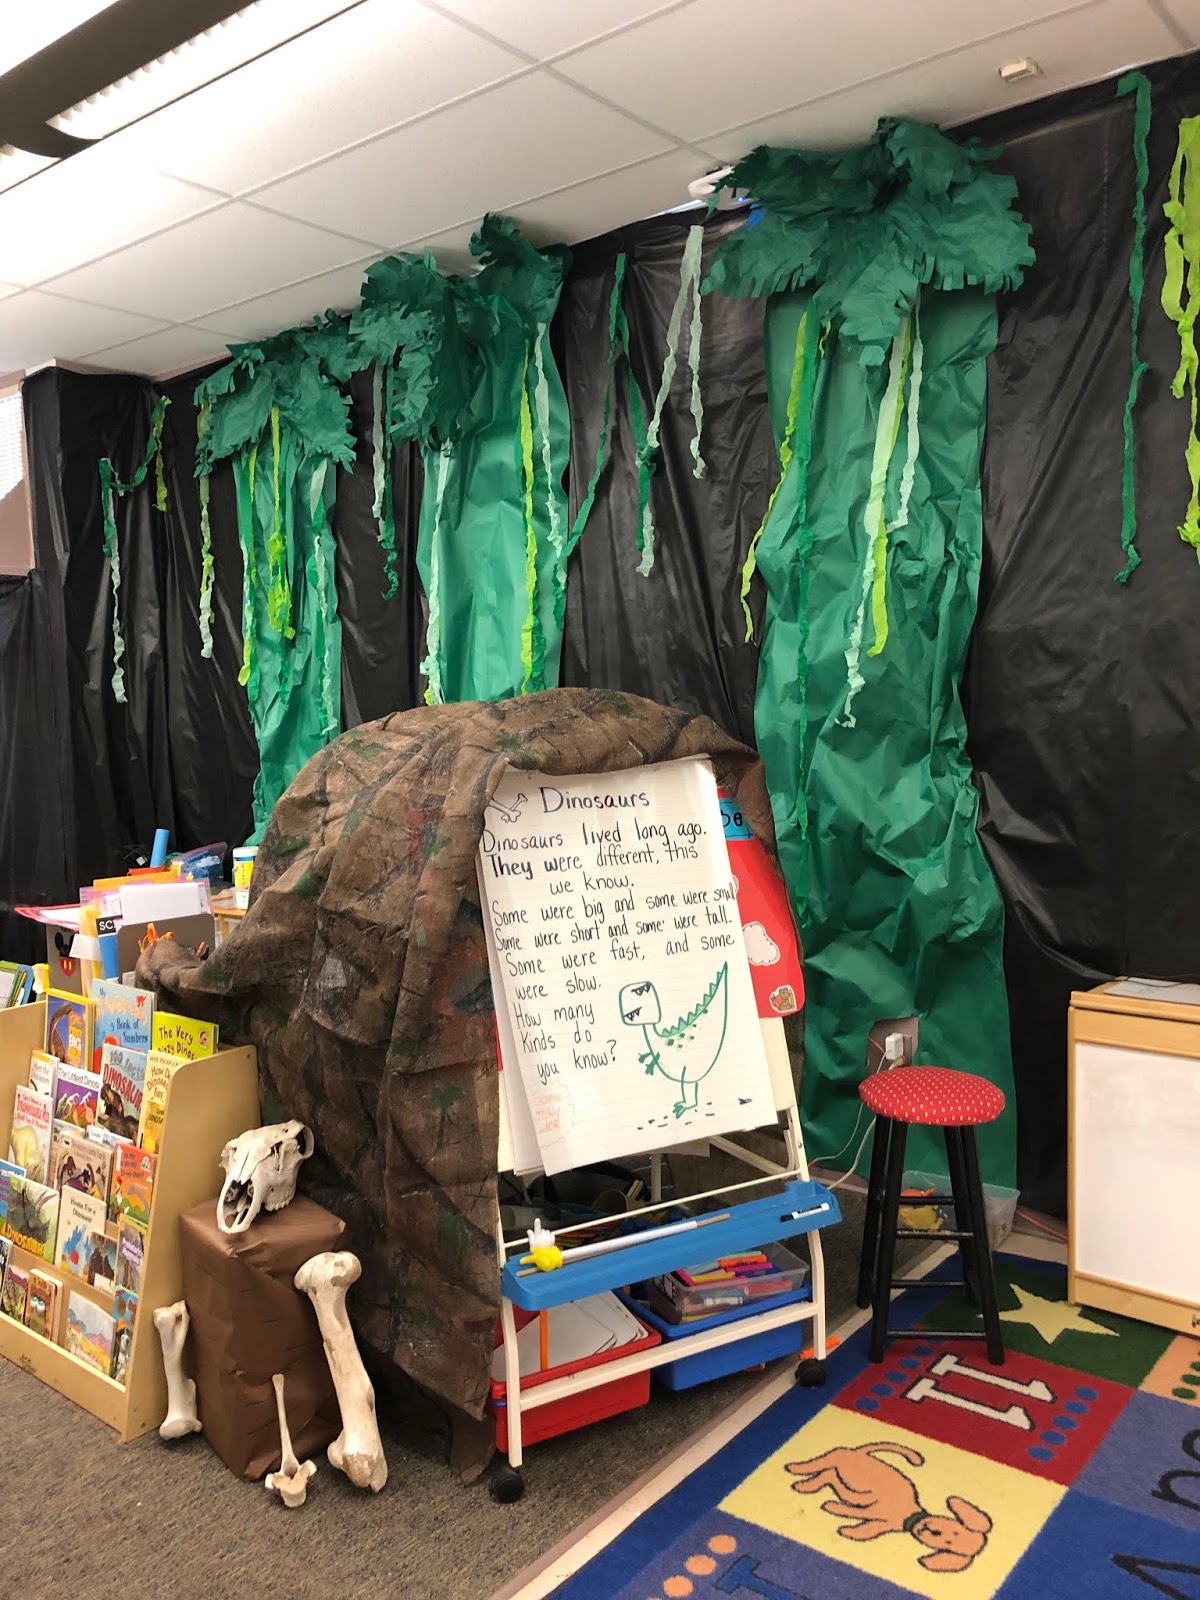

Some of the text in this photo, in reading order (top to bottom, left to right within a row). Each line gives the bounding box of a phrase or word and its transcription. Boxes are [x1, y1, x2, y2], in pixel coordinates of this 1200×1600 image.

[539, 786, 649, 813] Dinosaurs
[483, 817, 707, 853] Dinosaurs lived long ago.
[486, 840, 698, 880] They were different, this
[550, 871, 634, 895] we know.
[492, 900, 528, 926] Some
[541, 906, 574, 921] were
[582, 895, 605, 924] big
[614, 889, 635, 913] and
[645, 893, 677, 910] some
[683, 890, 708, 905] were
[495, 928, 522, 952] Some
[534, 932, 561, 948] were
[571, 922, 601, 943] short
[608, 914, 629, 938] and
[674, 914, 697, 930] were
[705, 904, 732, 925] tall.
[505, 932, 735, 977] Some were fast, and some
[515, 971, 601, 1000] were slow.
[513, 1002, 595, 1029] How many
[159, 1024, 194, 1046] The Very
[573, 1020, 592, 1044] do
[110, 1050, 124, 1065] 100
[537, 1039, 617, 1085] you know?
